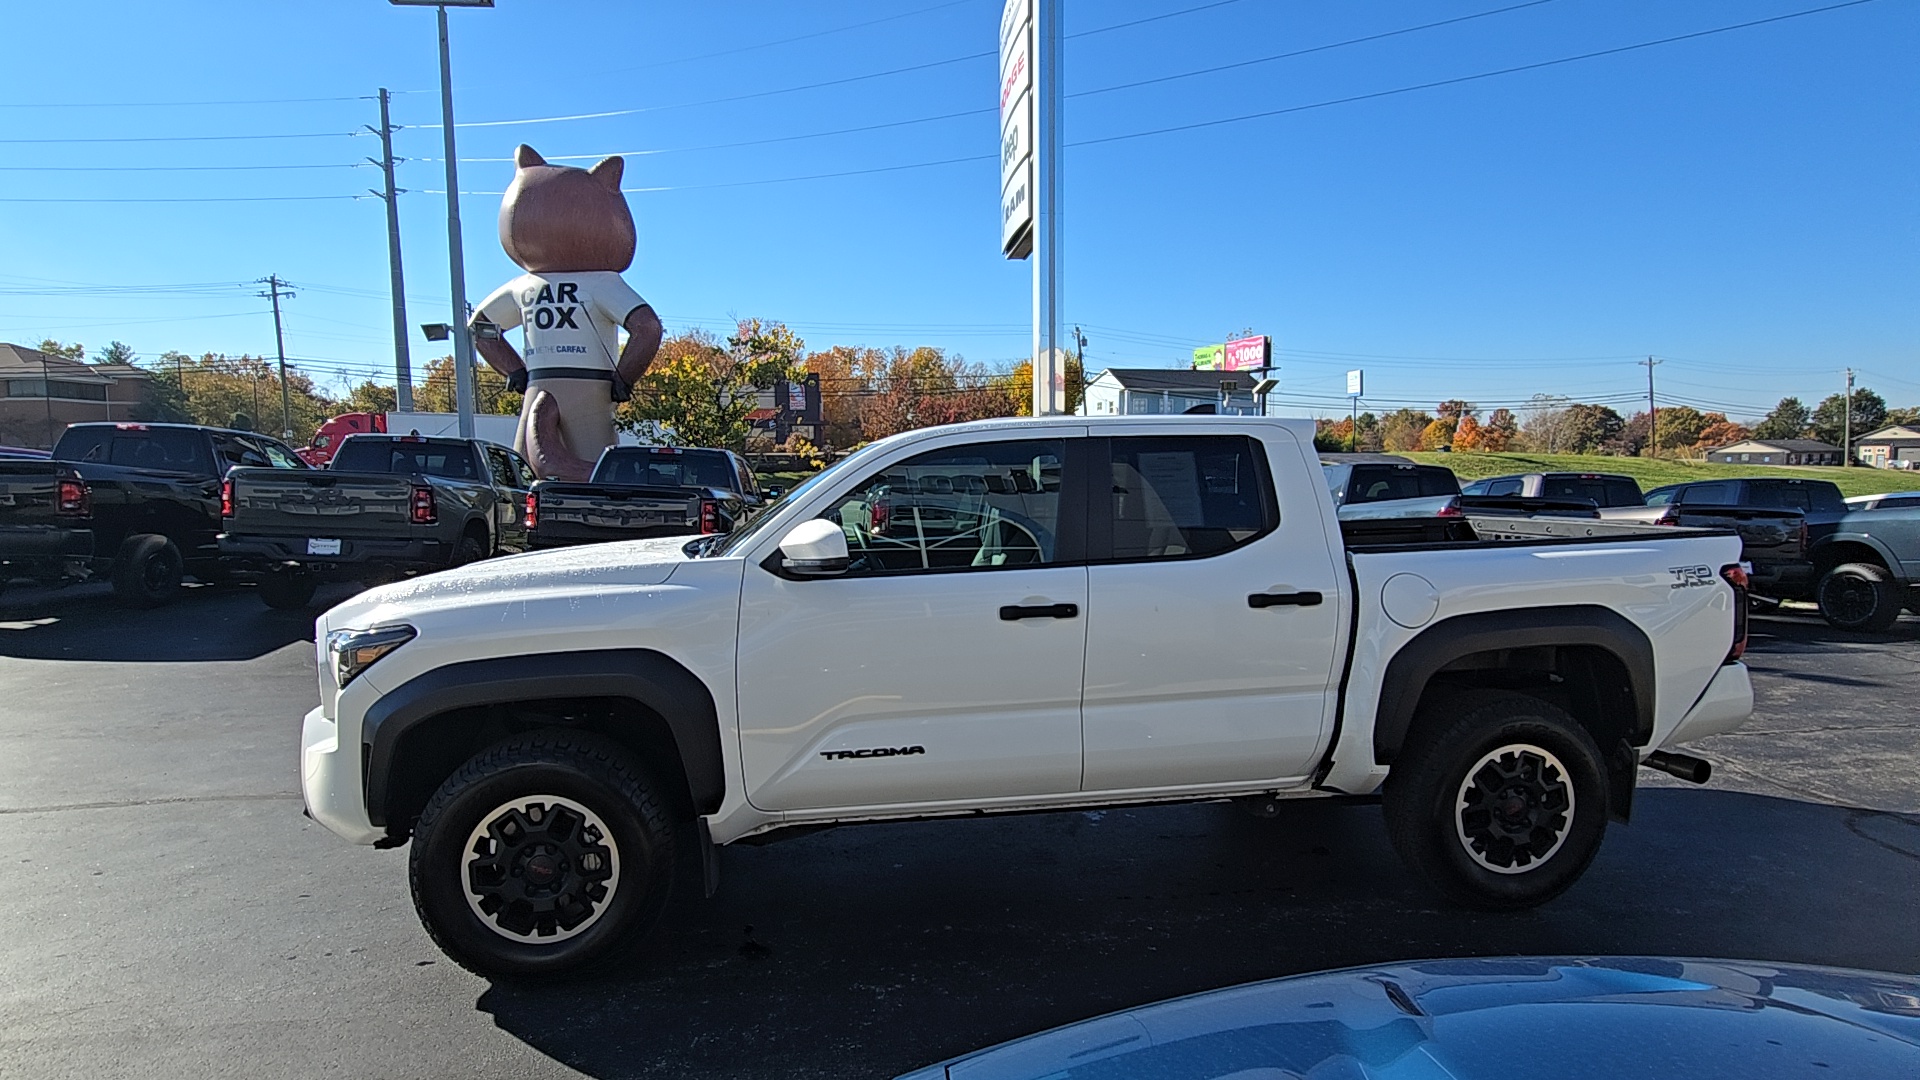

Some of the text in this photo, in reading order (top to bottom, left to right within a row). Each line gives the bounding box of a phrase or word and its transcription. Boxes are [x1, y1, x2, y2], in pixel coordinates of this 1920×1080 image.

[1005, 183, 1026, 224] RAM
[521, 283, 579, 308] CAR
[523, 307, 579, 332] FOX
[556, 345, 587, 353] CARFAX
[1235, 345, 1263, 362] $1000
[1668, 564, 1713, 582] TRD
[820, 745, 926, 761] TACOMA
